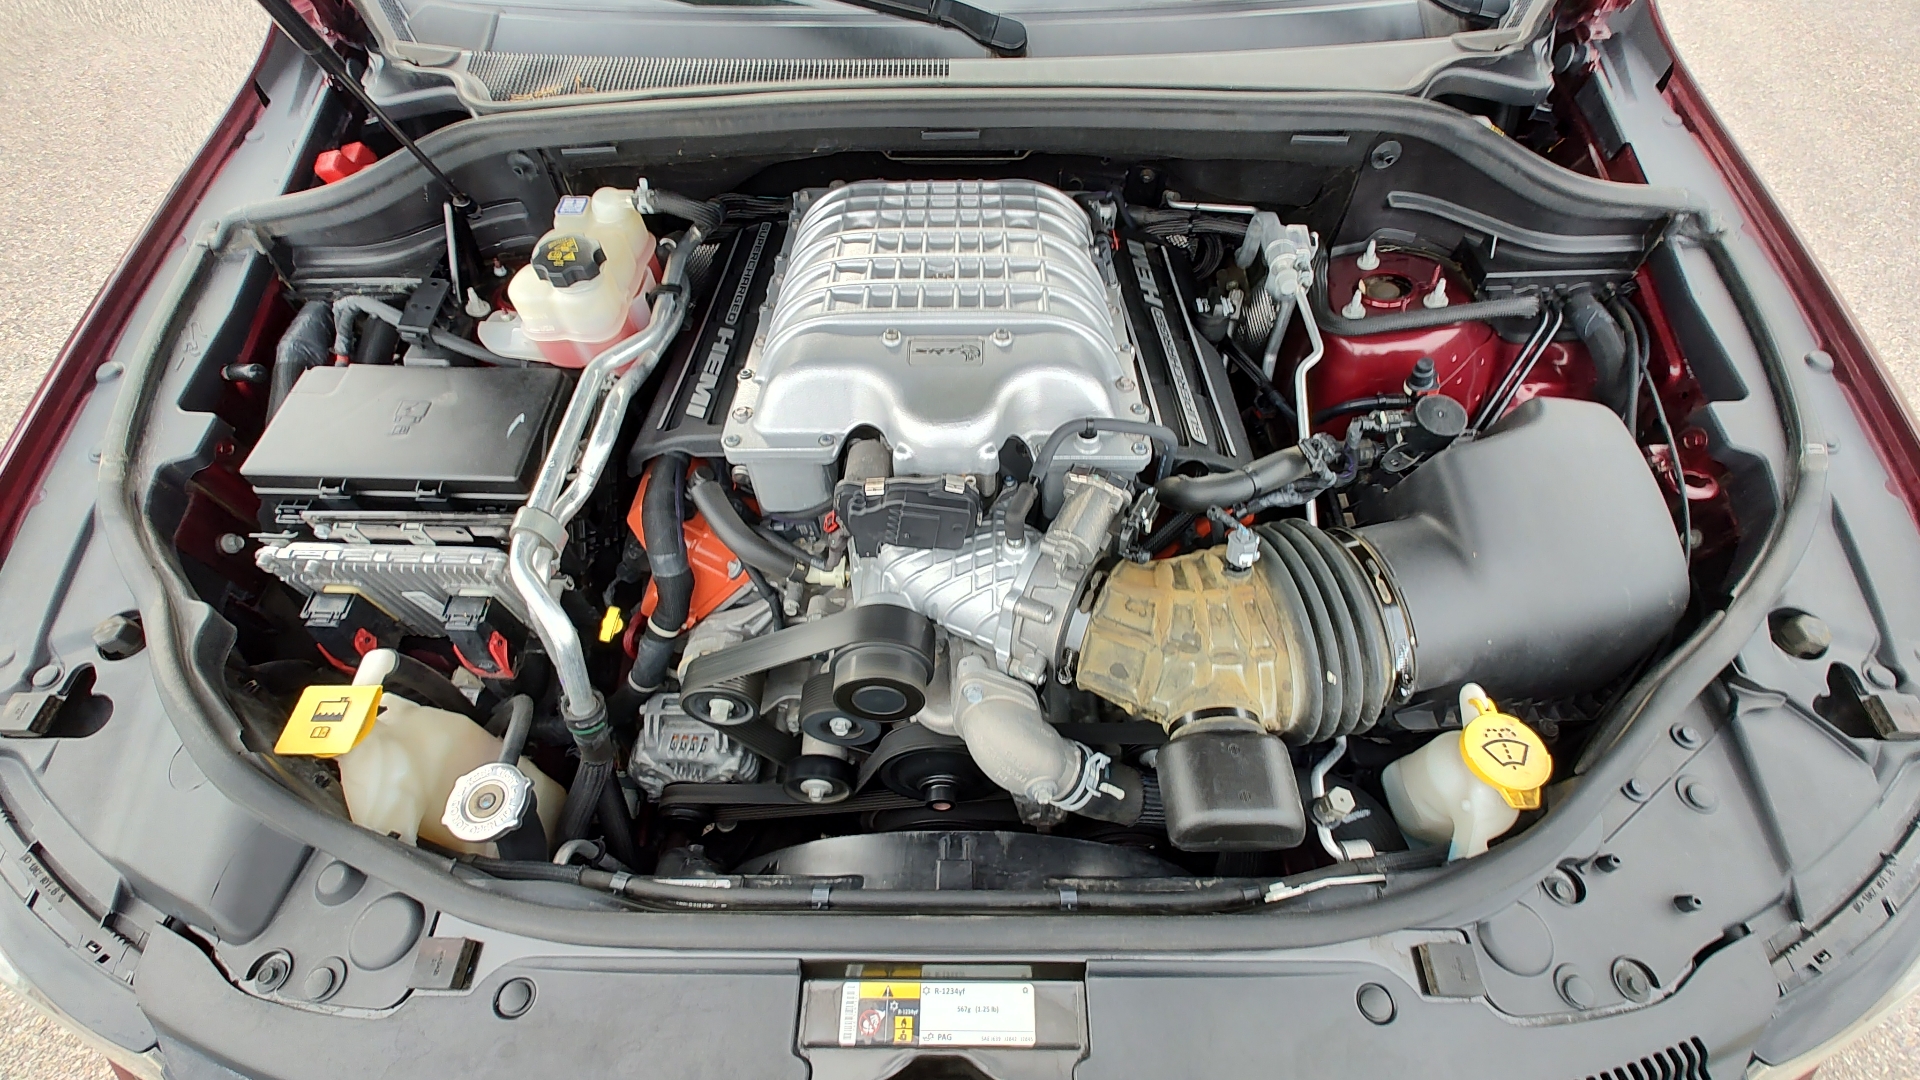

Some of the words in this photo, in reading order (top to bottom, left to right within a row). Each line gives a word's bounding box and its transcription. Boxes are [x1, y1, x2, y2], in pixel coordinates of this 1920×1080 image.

[726, 222, 772, 324] SUPERCHARGED
[1126, 238, 1164, 309] HEMI
[685, 327, 735, 419] HEMI
[1152, 308, 1206, 443] SUPERCHARGED
[934, 987, 966, 996] R-1234yf
[957, 1005, 972, 1014] 567g
[937, 1032, 953, 1042] PAG
